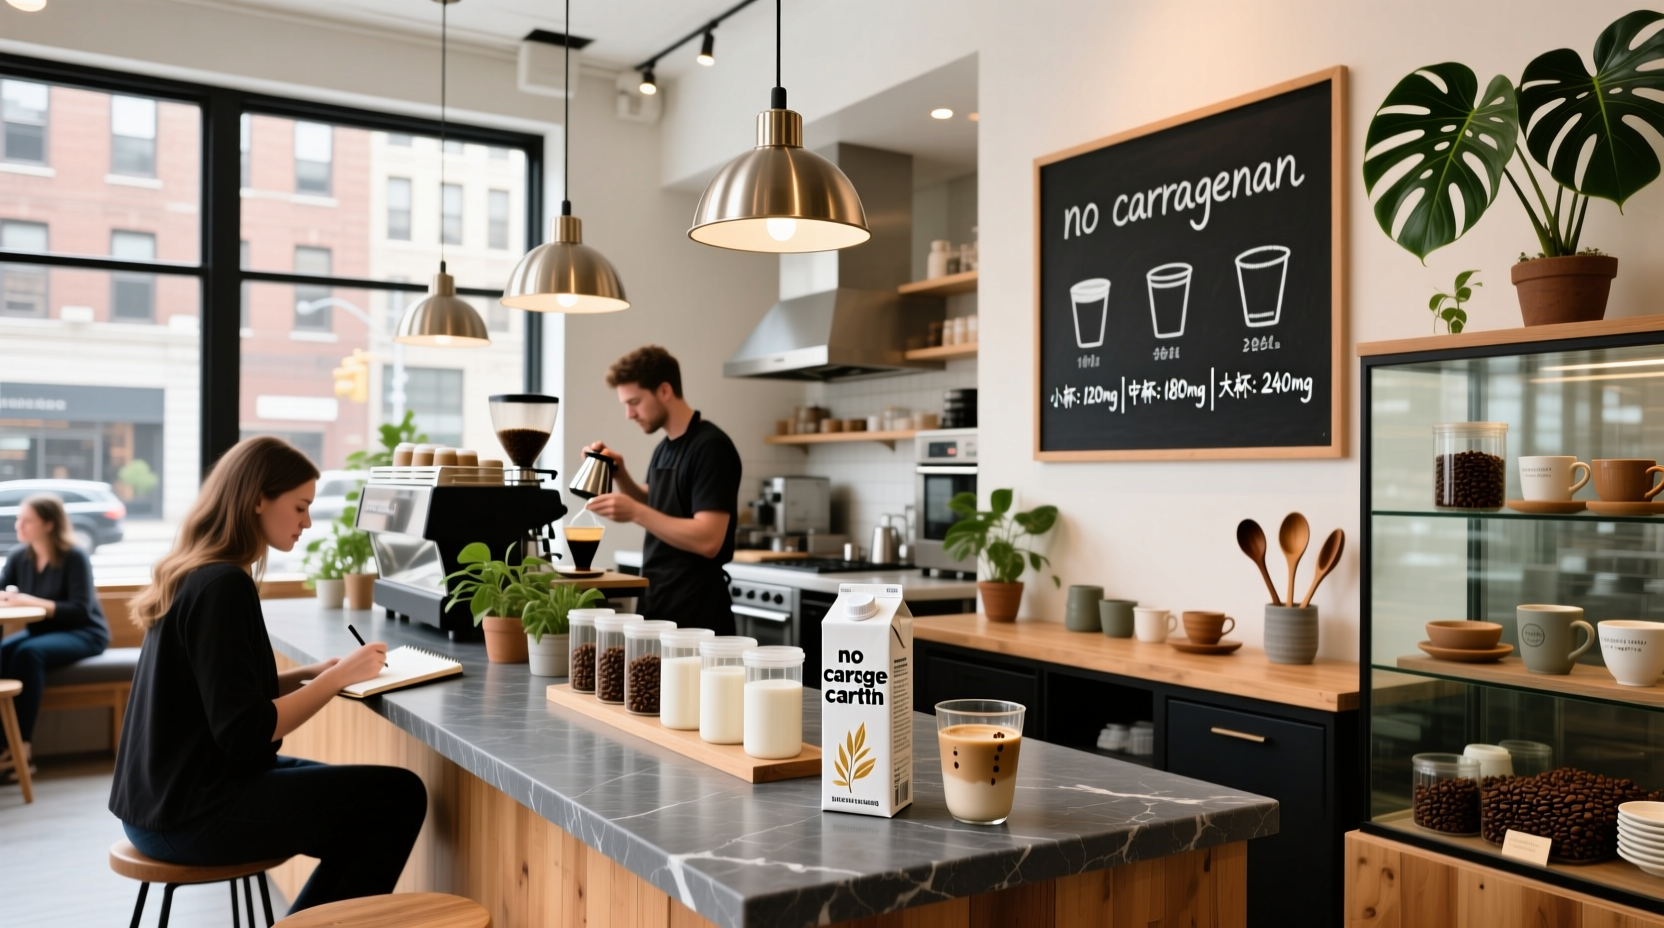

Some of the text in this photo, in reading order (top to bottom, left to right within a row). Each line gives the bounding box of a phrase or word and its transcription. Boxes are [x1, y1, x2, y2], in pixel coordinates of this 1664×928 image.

[1064, 154, 1306, 240] no carragenan
[1164, 378, 1206, 409] 180mg
[1218, 371, 1257, 400] 大杯:
[1261, 371, 1313, 403] 240mg
[838, 649, 864, 664] no
